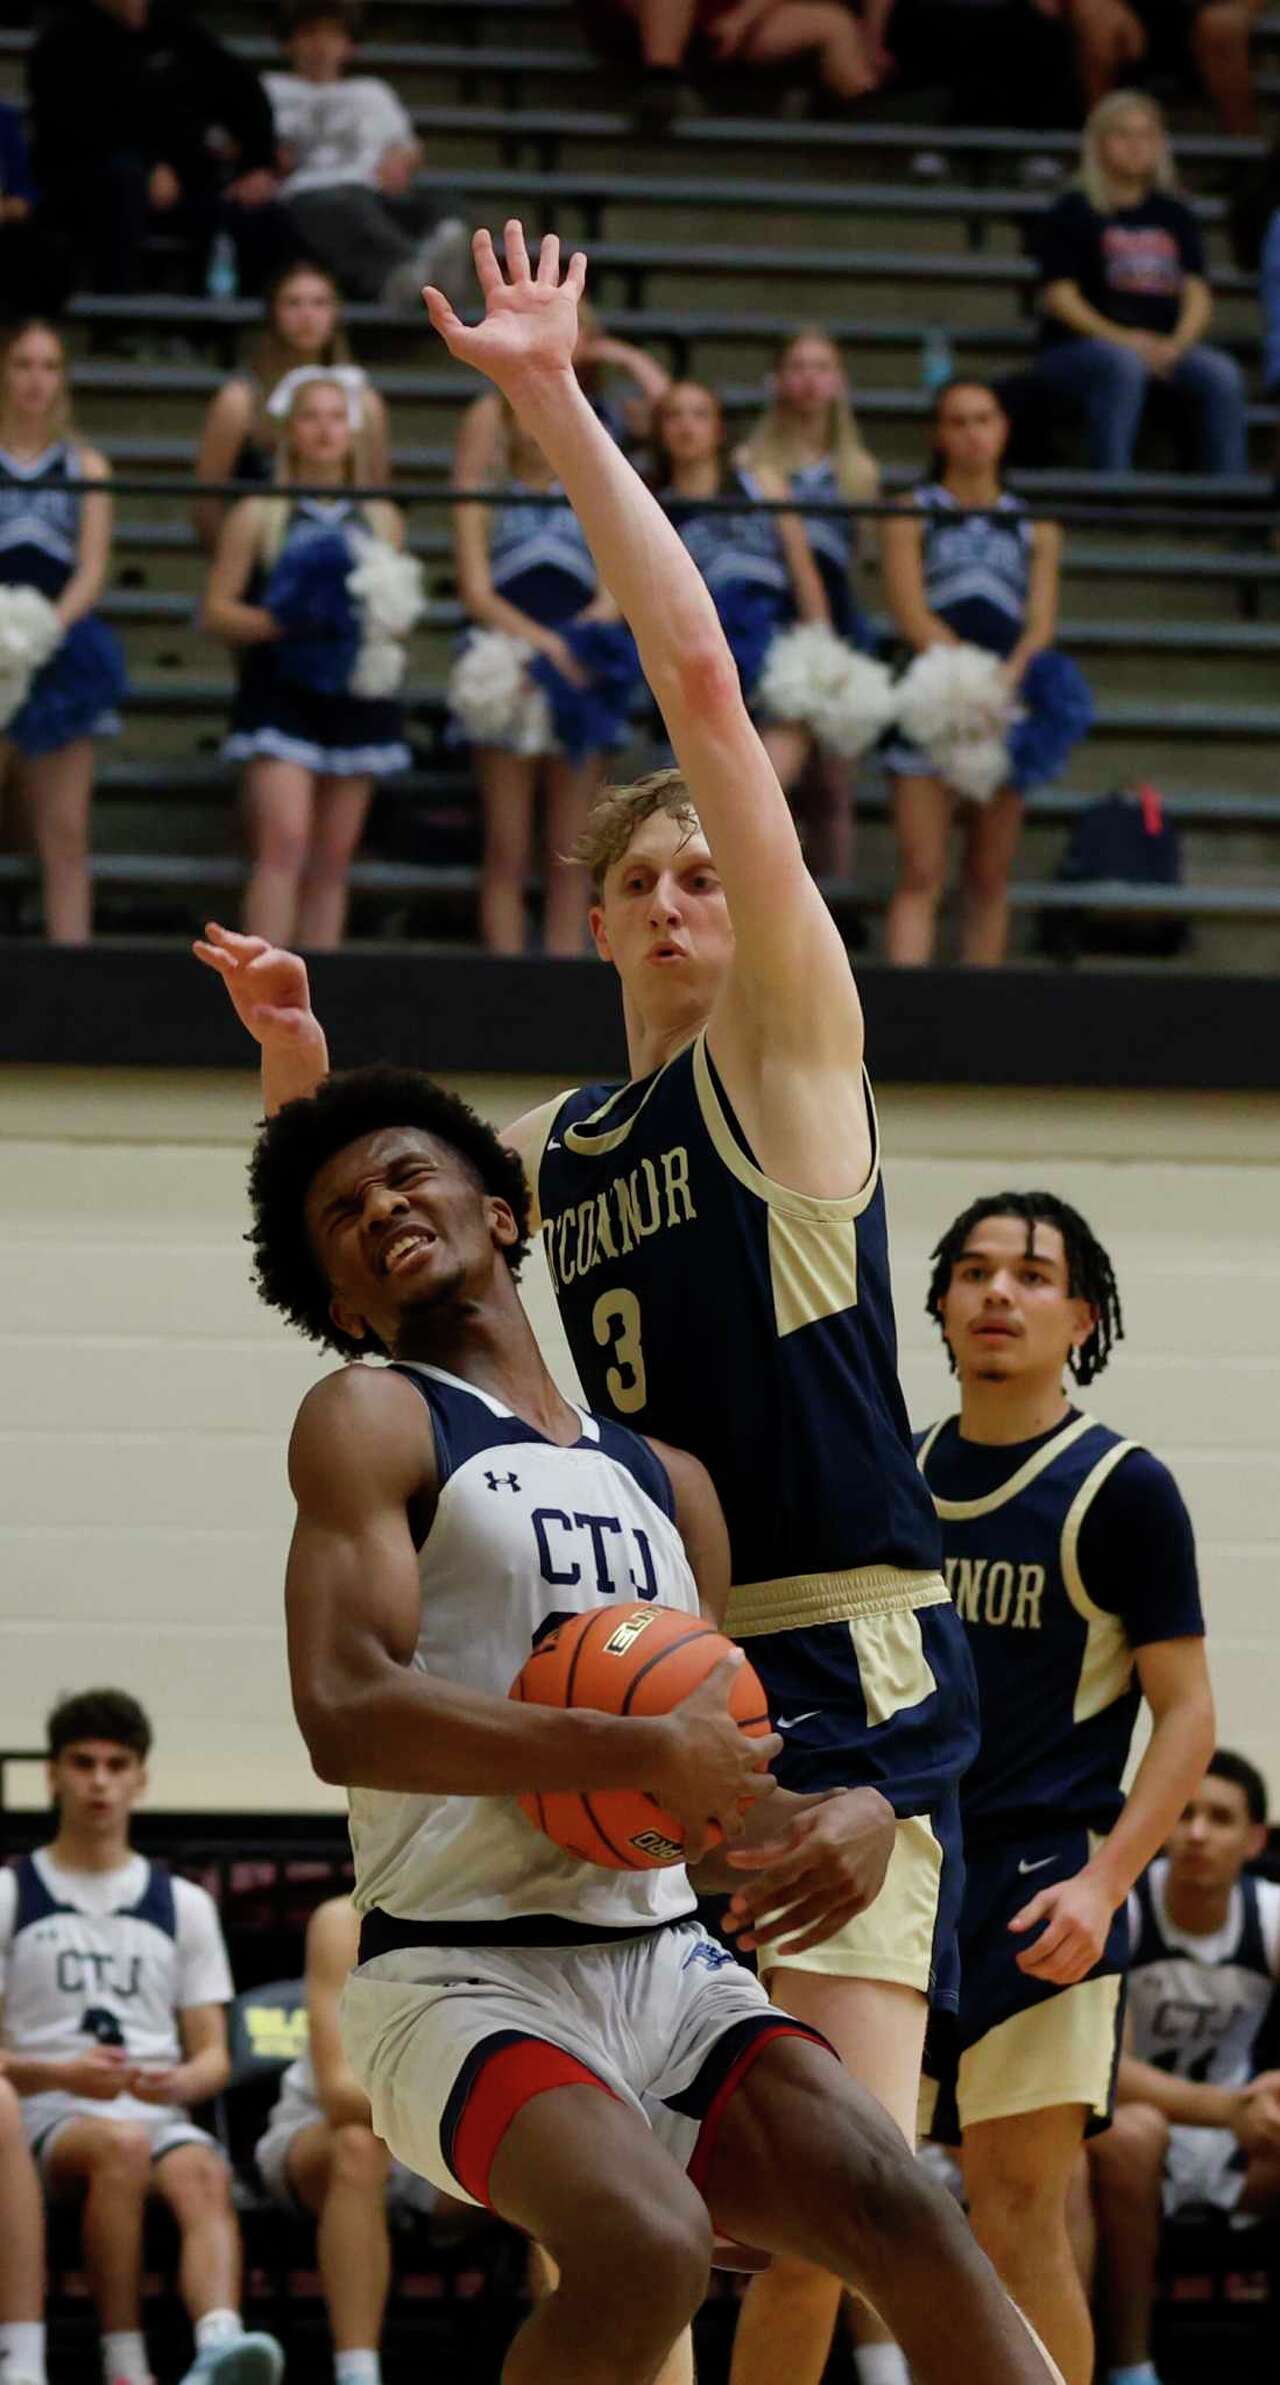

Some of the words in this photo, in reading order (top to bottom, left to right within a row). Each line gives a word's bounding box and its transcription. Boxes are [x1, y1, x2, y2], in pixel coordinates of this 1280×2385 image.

[592, 1288, 647, 1414] 3
[531, 1507, 659, 1601] CTJ
[56, 1949, 142, 2000] CTJ
[1151, 2000, 1244, 2040] CTJ
